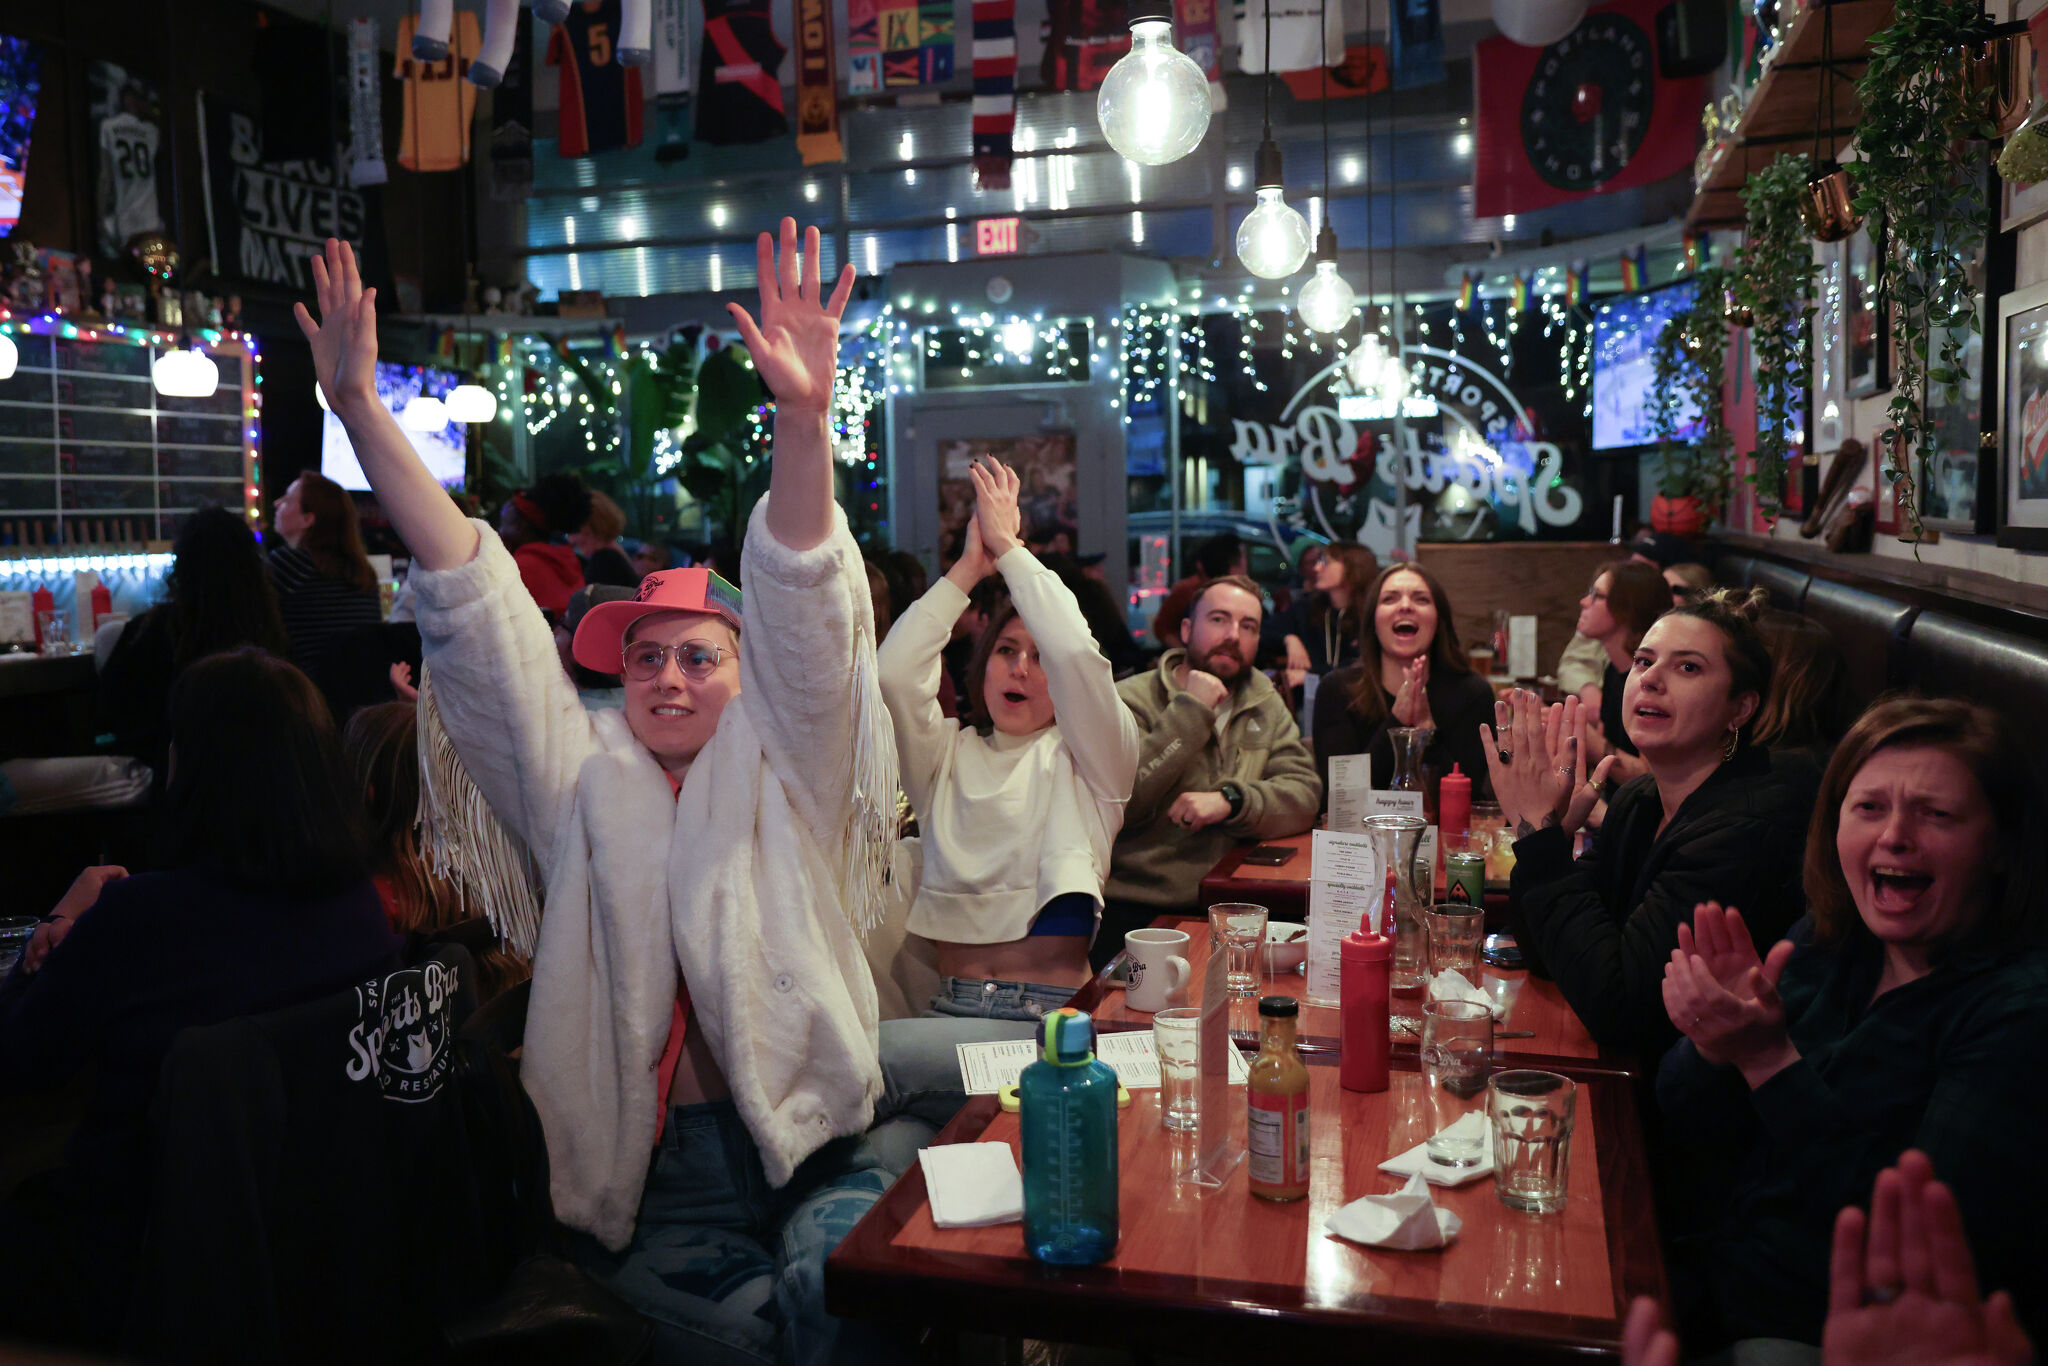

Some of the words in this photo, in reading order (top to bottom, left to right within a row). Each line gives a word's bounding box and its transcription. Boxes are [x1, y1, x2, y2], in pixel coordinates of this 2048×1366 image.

[587, 22, 612, 68] 5
[115, 138, 151, 180] 20
[236, 170, 366, 242] LIVES
[976, 217, 1020, 255] EXIT
[346, 984, 422, 1081] Sports
[424, 963, 459, 1015] Bra
